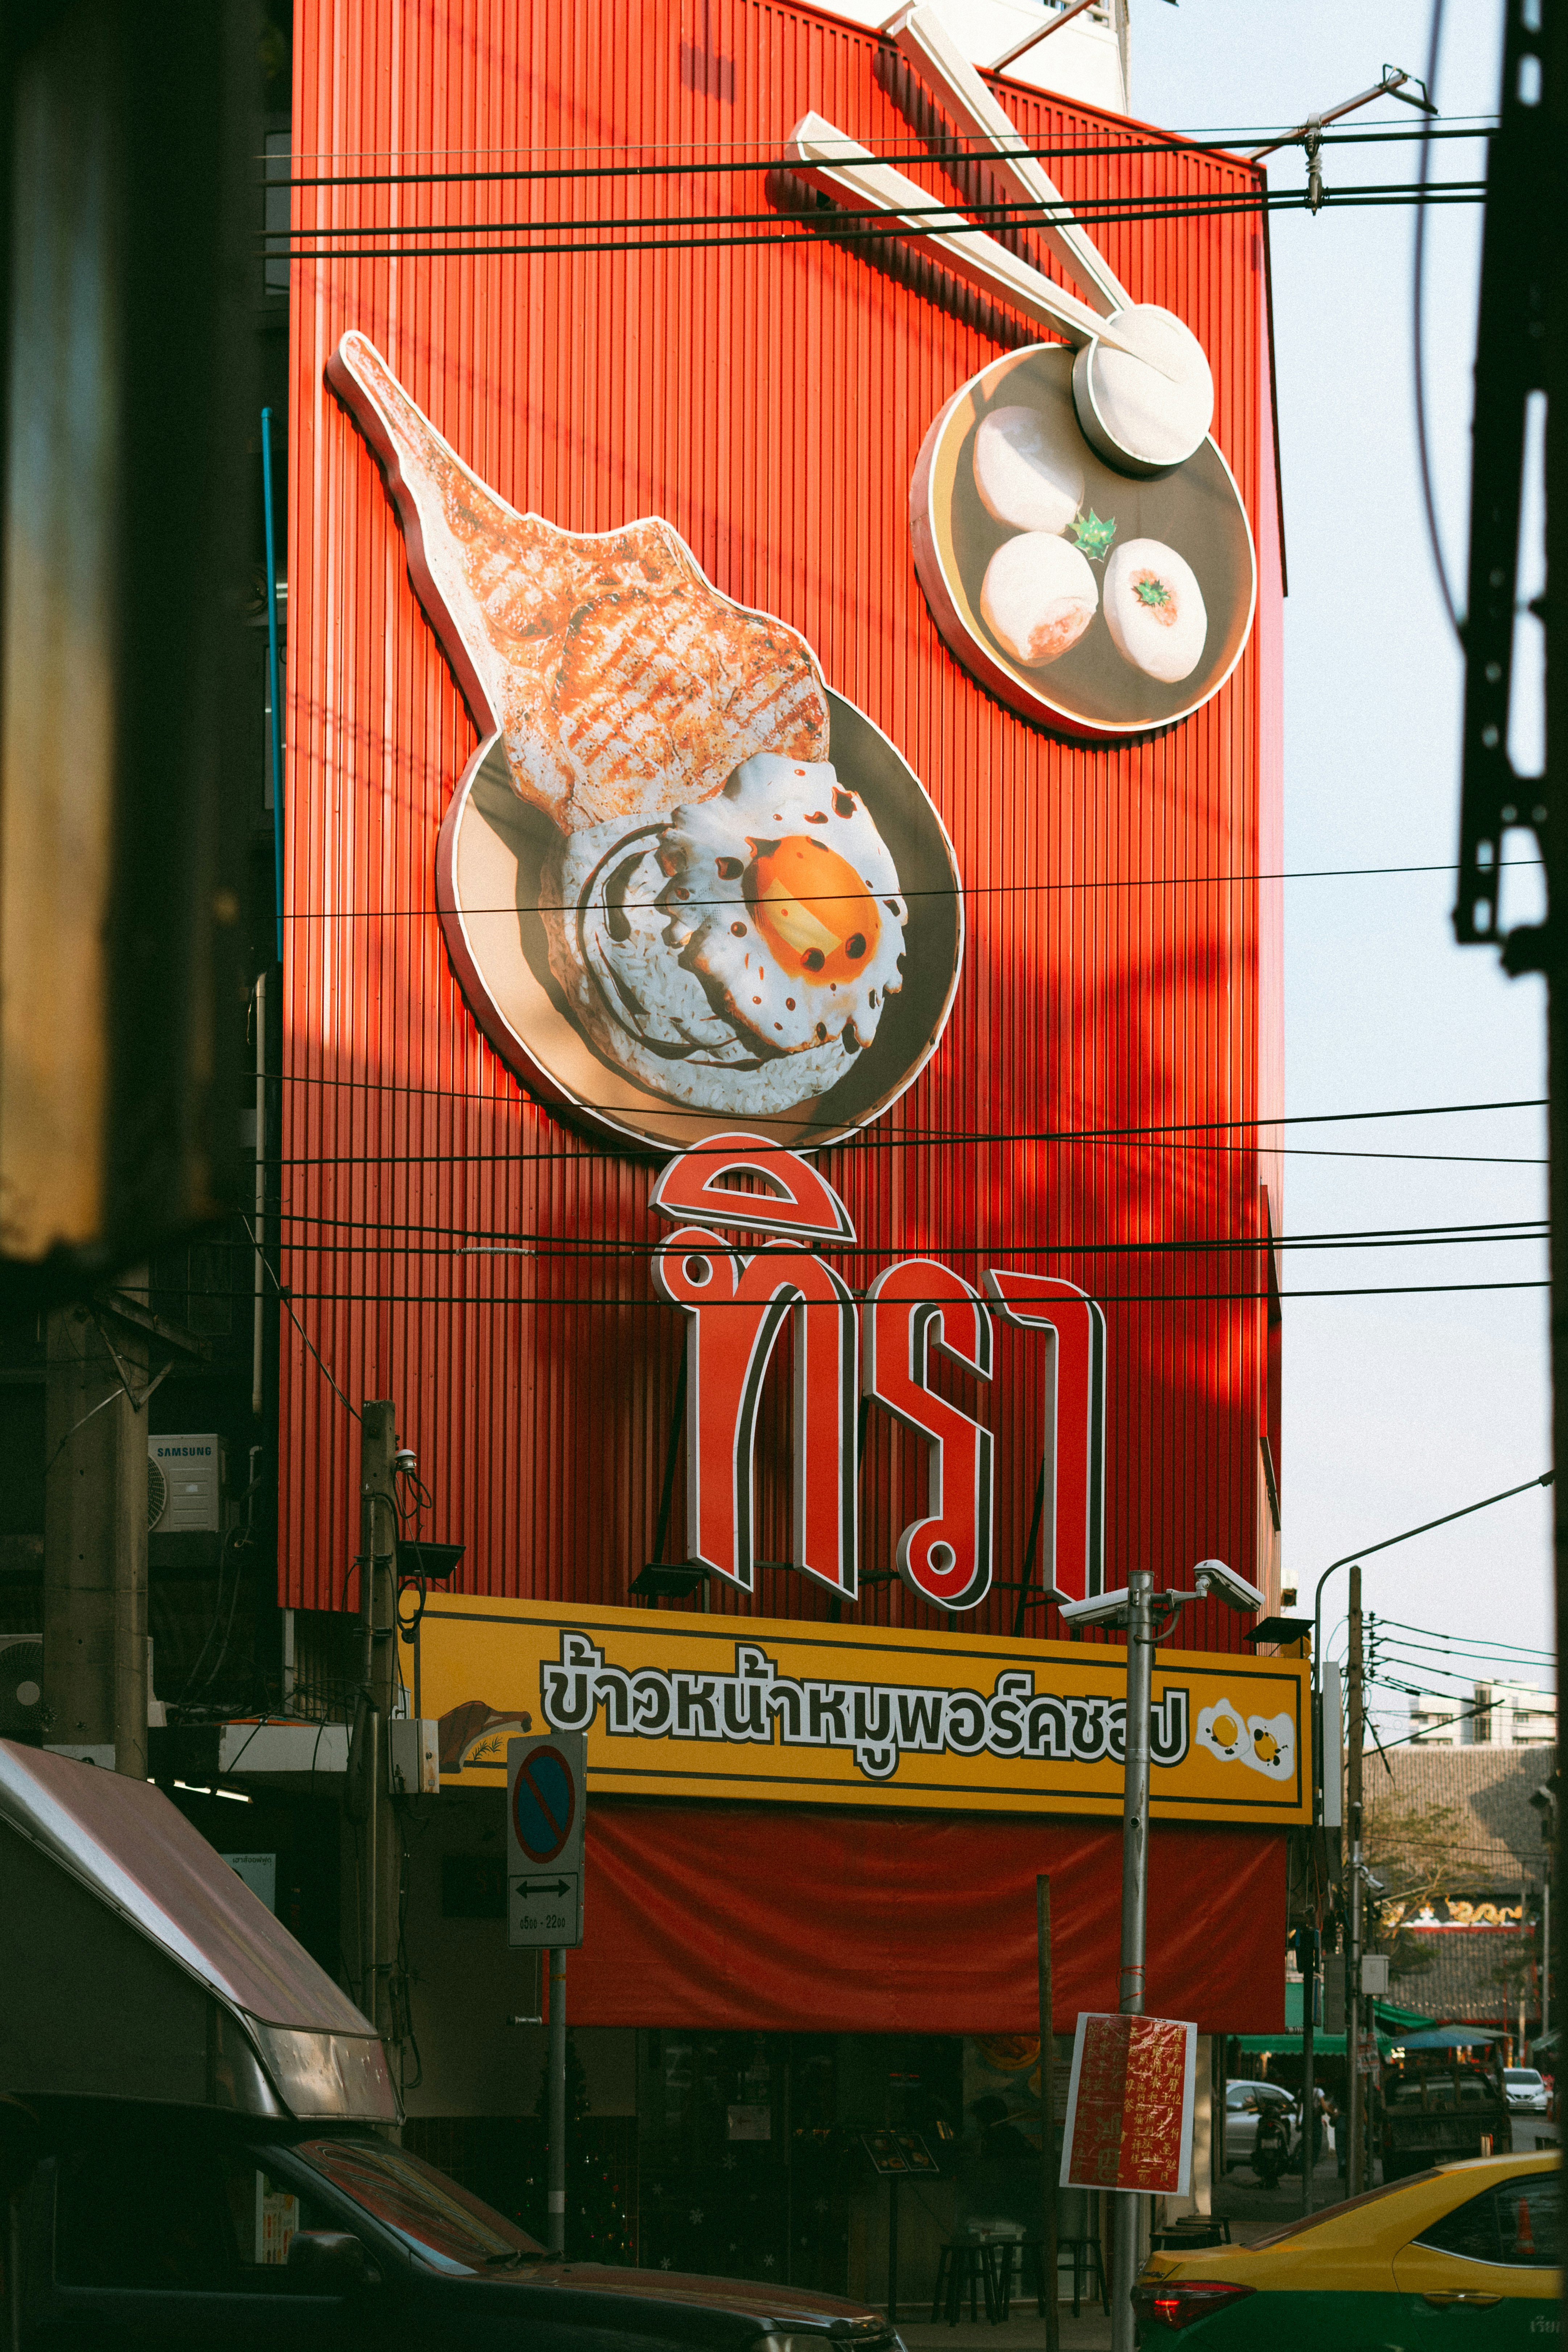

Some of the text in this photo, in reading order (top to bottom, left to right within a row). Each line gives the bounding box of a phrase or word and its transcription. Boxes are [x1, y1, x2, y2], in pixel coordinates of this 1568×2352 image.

[157, 1447, 211, 1457] SAMSUNG
[520, 1915, 537, 1929] 0500
[546, 1914, 565, 1928] 2200
